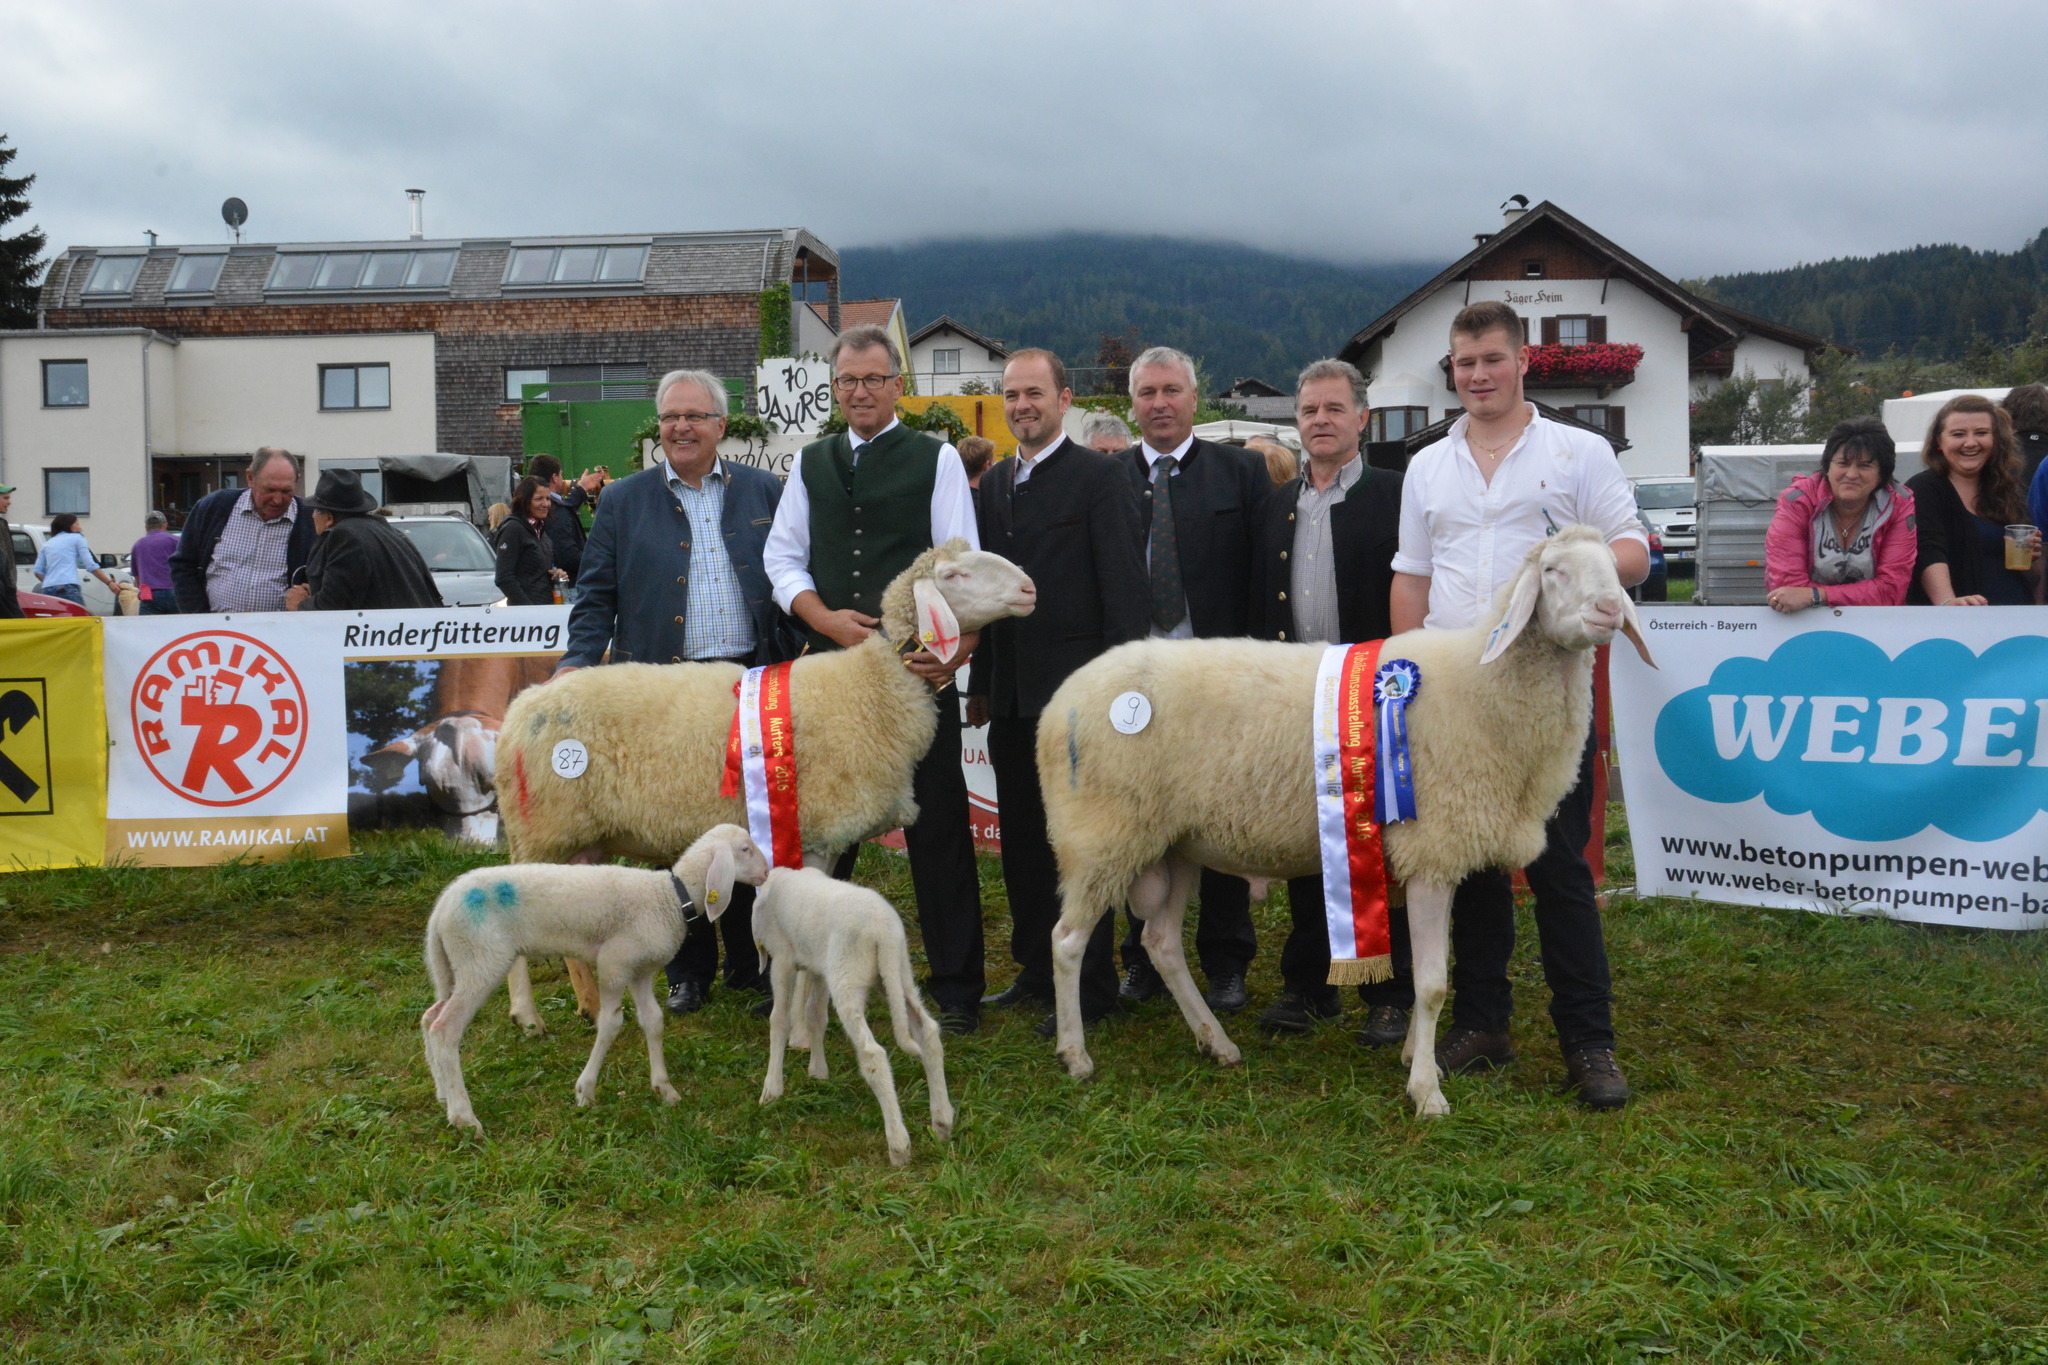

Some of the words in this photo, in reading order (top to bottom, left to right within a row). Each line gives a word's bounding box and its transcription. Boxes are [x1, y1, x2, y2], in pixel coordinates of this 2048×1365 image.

[1534, 289, 1563, 304] Heim
[781, 364, 808, 393] 70
[758, 383, 830, 435] JAHRE
[343, 620, 561, 652] Rinderfütterung
[1649, 618, 1708, 630] Österreich
[1717, 620, 1758, 632] Bayern
[140, 640, 299, 764] RAMIKAL
[769, 717, 784, 757] Mutters
[1708, 694, 2048, 768] WEBE
[558, 748, 584, 770] 87
[963, 747, 994, 766] UA
[774, 765, 790, 791] 2016
[1351, 756, 1367, 803] Mutters
[127, 826, 329, 848] WWW.RAMIKAL.AT
[1355, 812, 1372, 841] 2016
